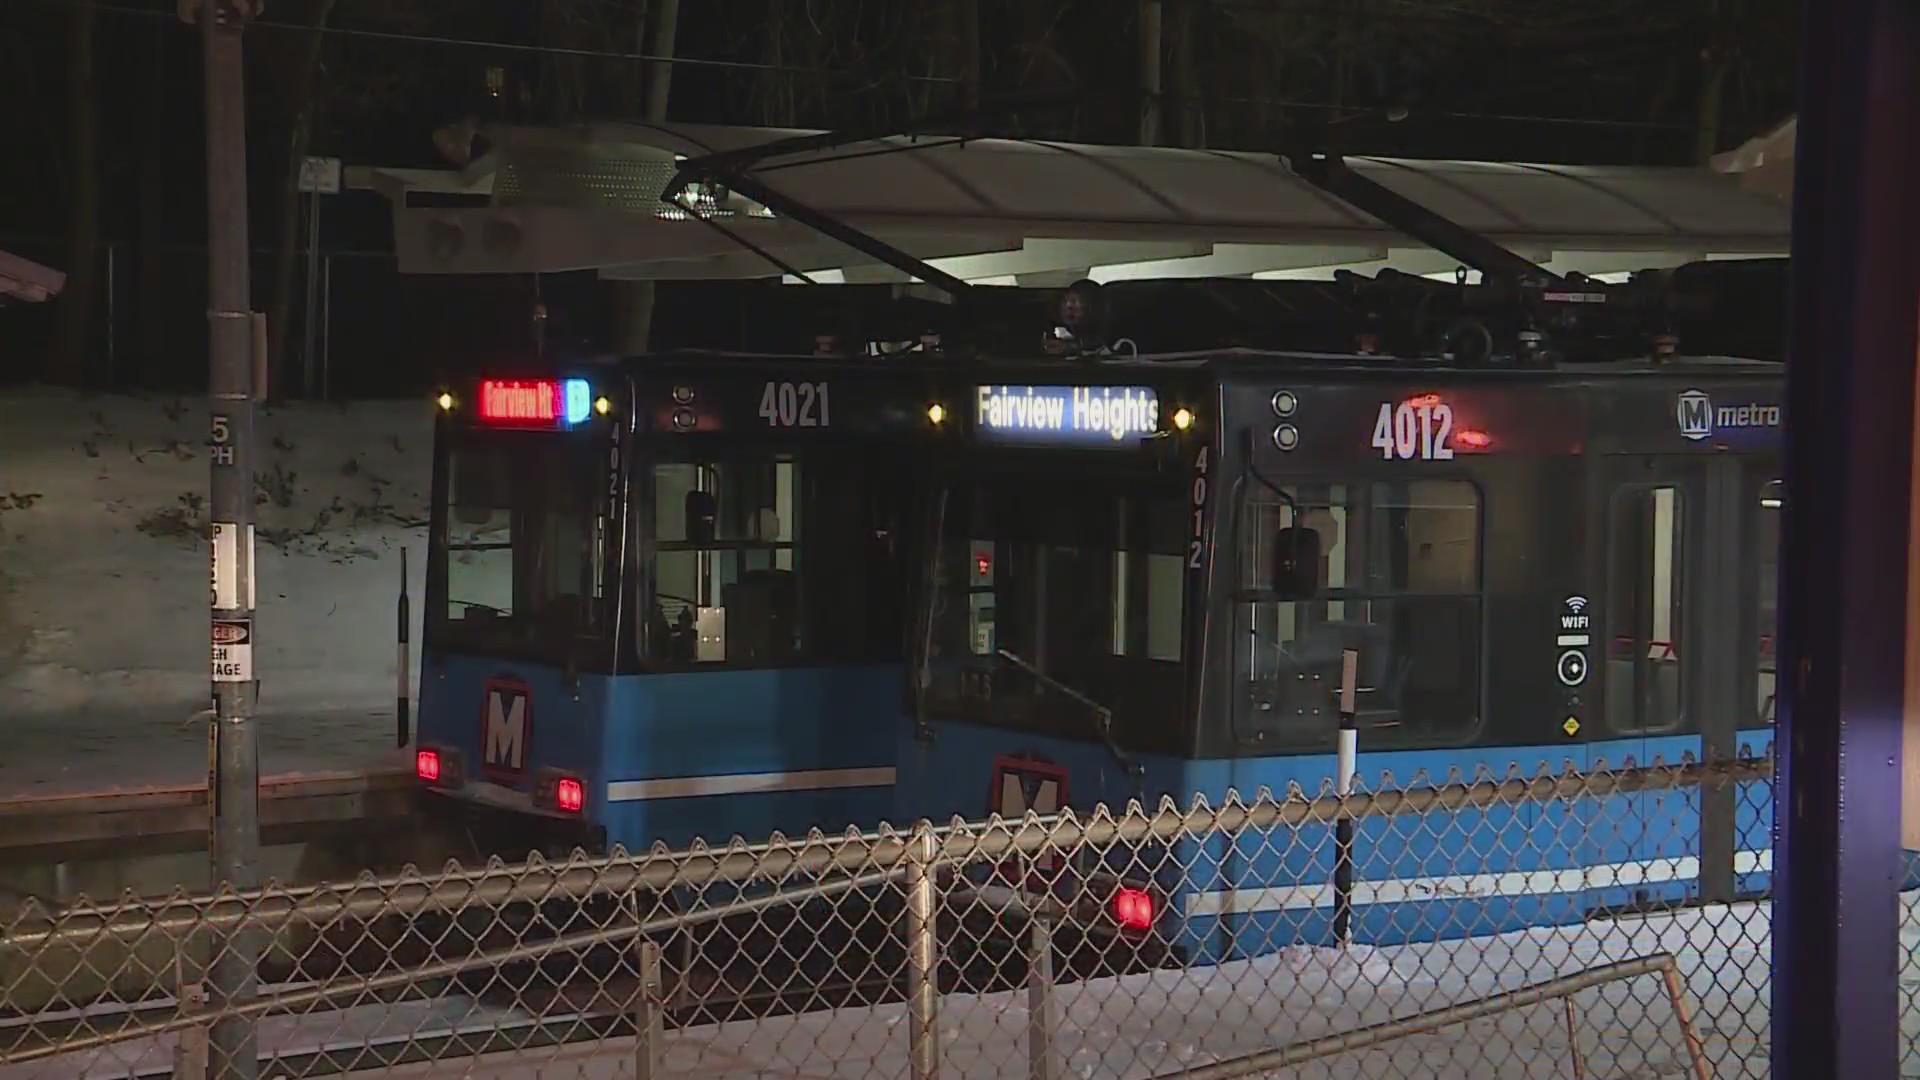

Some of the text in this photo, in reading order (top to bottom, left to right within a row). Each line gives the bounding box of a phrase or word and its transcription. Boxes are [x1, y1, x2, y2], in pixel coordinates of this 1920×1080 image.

[483, 381, 537, 418] Fairview
[758, 381, 829, 427] 4021
[977, 385, 1159, 441] Fairview Heights
[1716, 405, 1780, 427] metro
[211, 416, 230, 444] 5
[1372, 403, 1454, 460] 4012
[608, 422, 620, 520] 4021
[1190, 446, 1208, 568] 4012
[1561, 615, 1590, 629] WIFI
[486, 691, 527, 769] M
